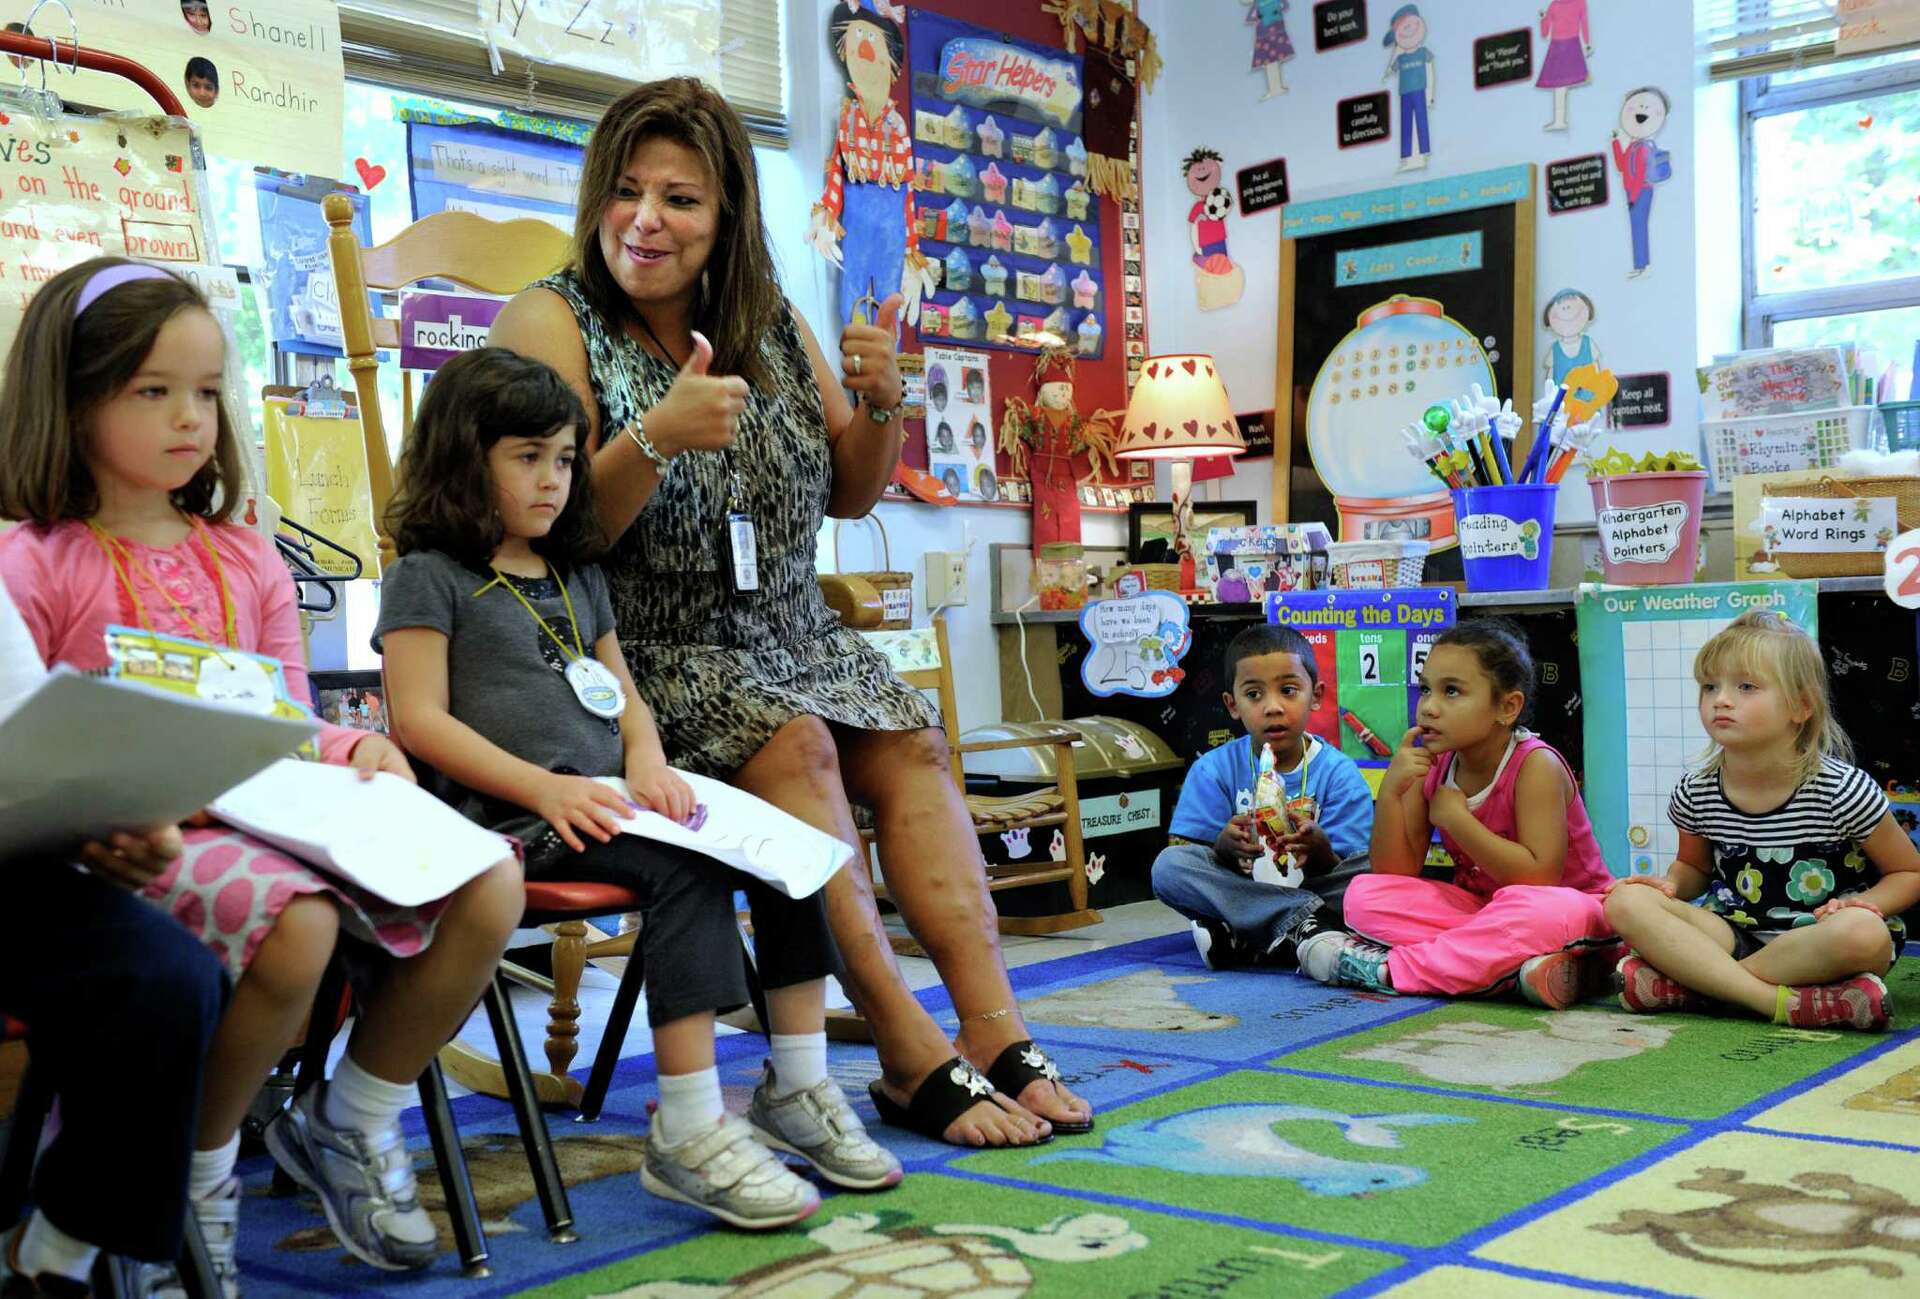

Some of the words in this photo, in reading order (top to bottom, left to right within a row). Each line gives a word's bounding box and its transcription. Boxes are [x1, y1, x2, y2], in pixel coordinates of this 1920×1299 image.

[229, 8, 326, 52] Shanell
[944, 51, 992, 93] Star
[994, 53, 1056, 98] Helpers
[231, 70, 318, 113] Randhir
[18, 174, 46, 196] on
[62, 165, 102, 202] the
[118, 178, 196, 215] ground.
[935, 351, 952, 361] Table
[954, 353, 980, 362] Captains
[1749, 442, 1809, 457] Rhyming
[1751, 461, 1791, 474] Books
[308, 497, 357, 526] Forms
[1602, 505, 1682, 525] Kindergarten
[1781, 508, 1846, 526] Alphabet
[1460, 516, 1508, 532] reading
[1611, 525, 1669, 542] Alphabet
[1782, 528, 1819, 542] Word
[1825, 527, 1867, 544] Rings
[1613, 542, 1666, 558] Pointers
[1604, 597, 1637, 613] Our
[1643, 594, 1720, 612] Weather
[1727, 590, 1786, 609] Graph
[1278, 604, 1357, 627] Counting
[1362, 604, 1391, 624] the
[1397, 604, 1445, 627] Days
[1303, 632, 1328, 644] reds
[1360, 633, 1383, 644] tens
[1363, 652, 1376, 680] 2
[1081, 814, 1122, 828] TREASURE
[1127, 808, 1151, 822] CHEST
